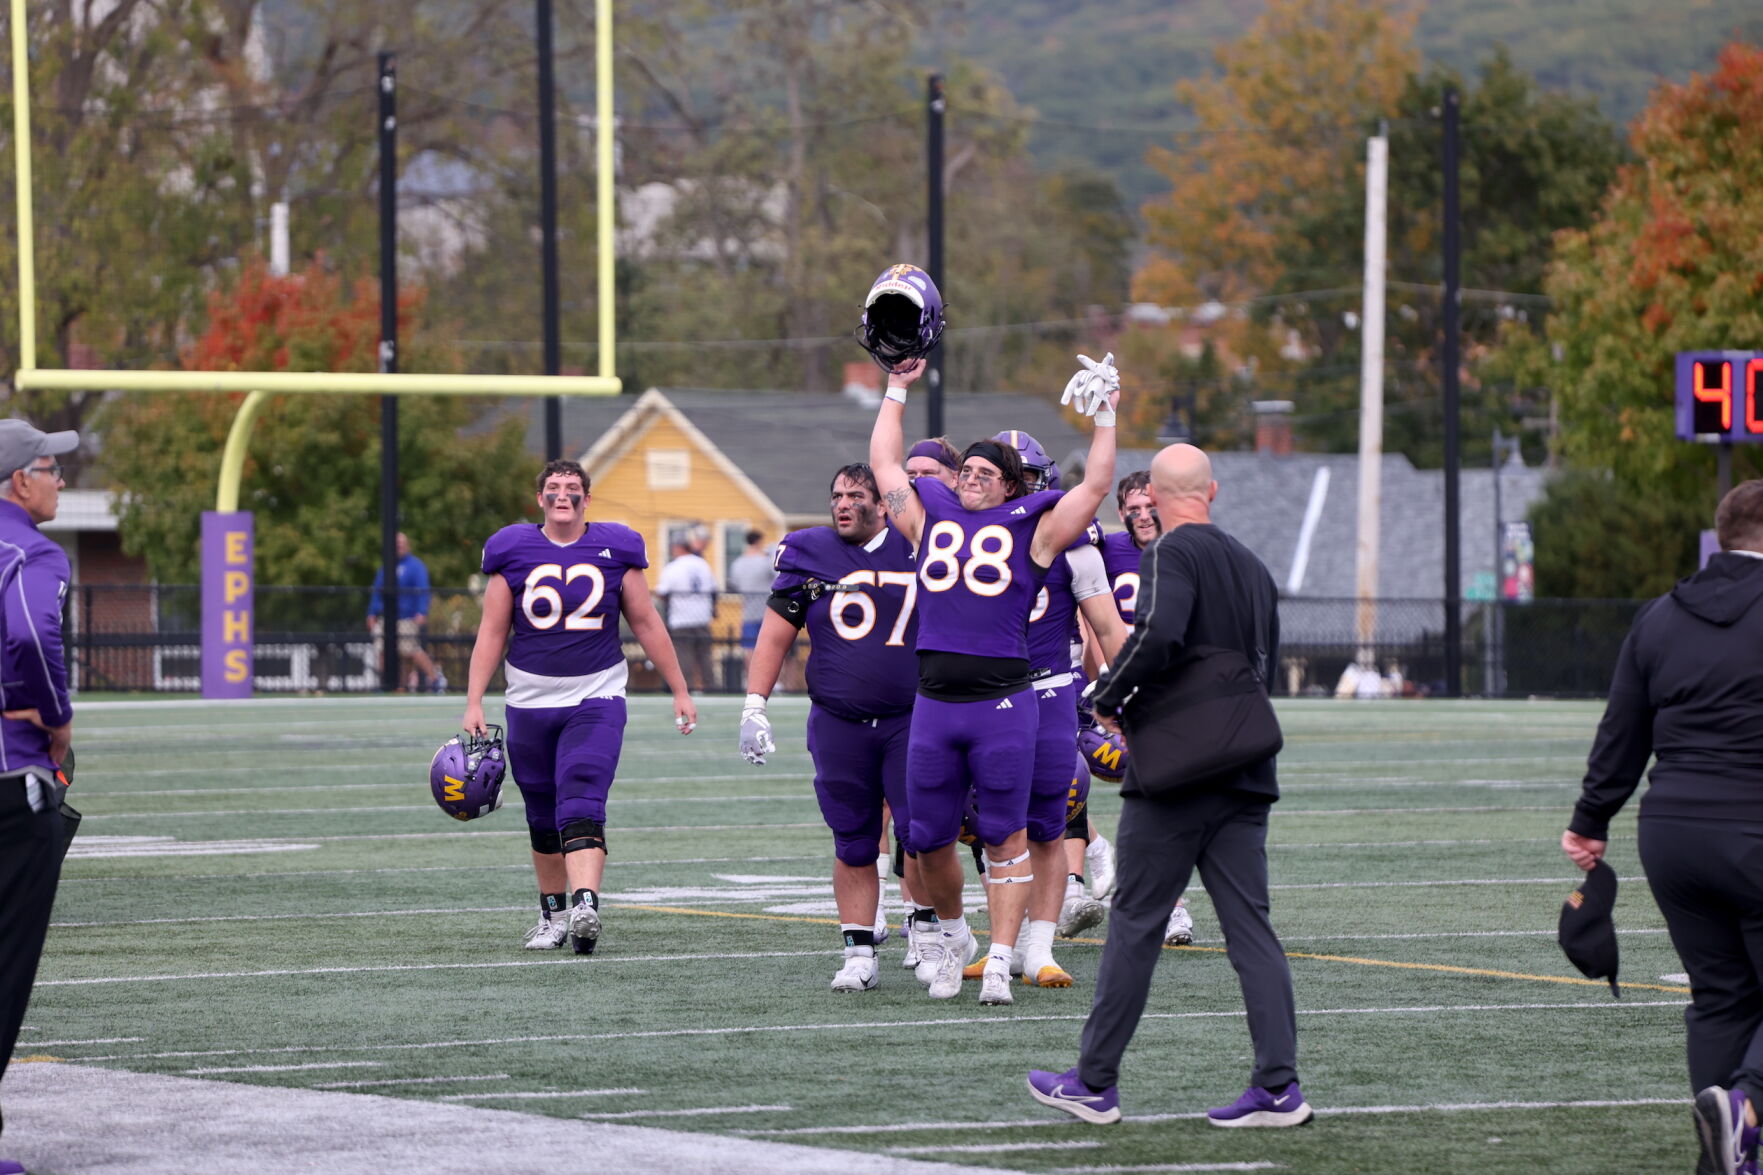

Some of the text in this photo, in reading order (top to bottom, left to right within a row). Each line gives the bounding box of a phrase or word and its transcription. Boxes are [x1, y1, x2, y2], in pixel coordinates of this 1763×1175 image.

[521, 563, 606, 630] 62
[920, 520, 1014, 597] 88
[223, 531, 250, 684] EPHS
[829, 569, 917, 646] 67
